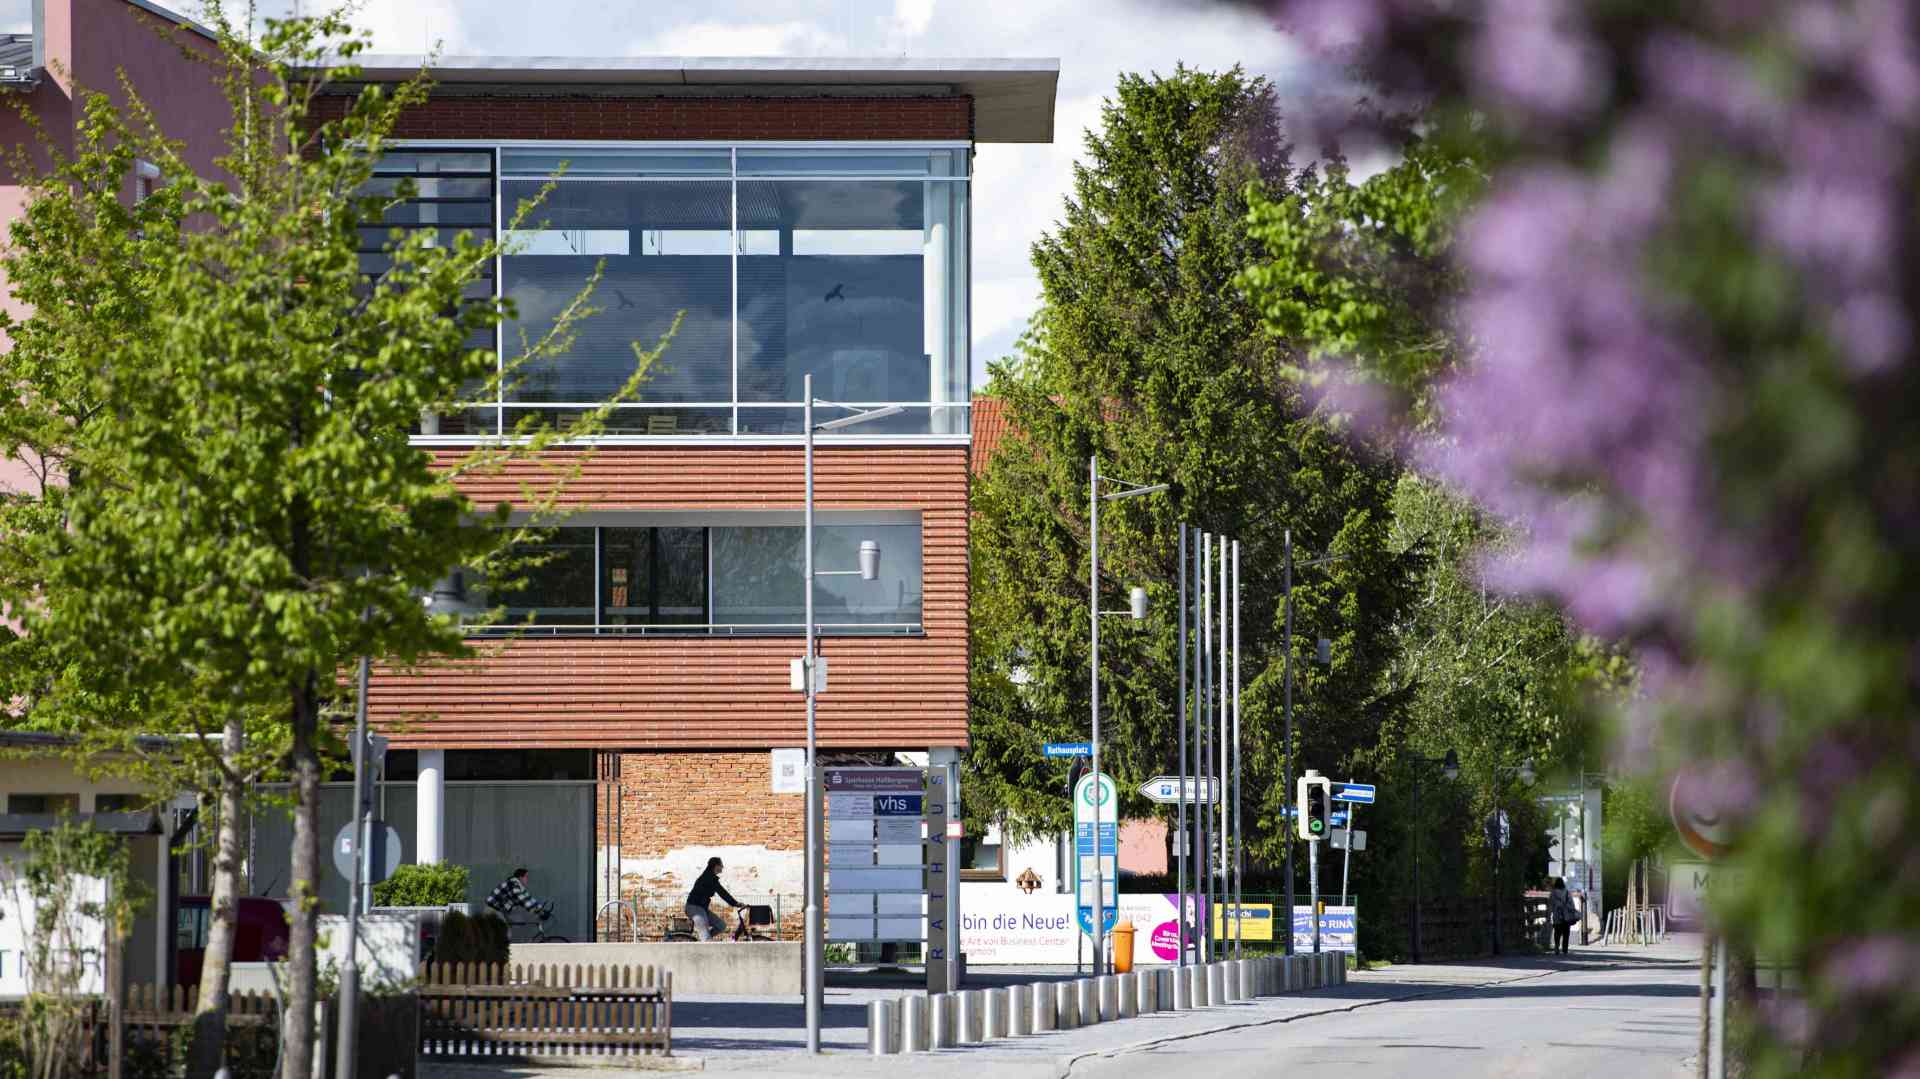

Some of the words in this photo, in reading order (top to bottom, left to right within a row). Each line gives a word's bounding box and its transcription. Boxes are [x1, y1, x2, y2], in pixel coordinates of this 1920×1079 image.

[1047, 745, 1089, 755] Rathausplatz
[880, 796, 908, 810] vhs
[931, 775, 945, 961] RATHAUS
[963, 912, 987, 930] bin
[993, 912, 1017, 930] die
[1022, 912, 1070, 930] Neue!
